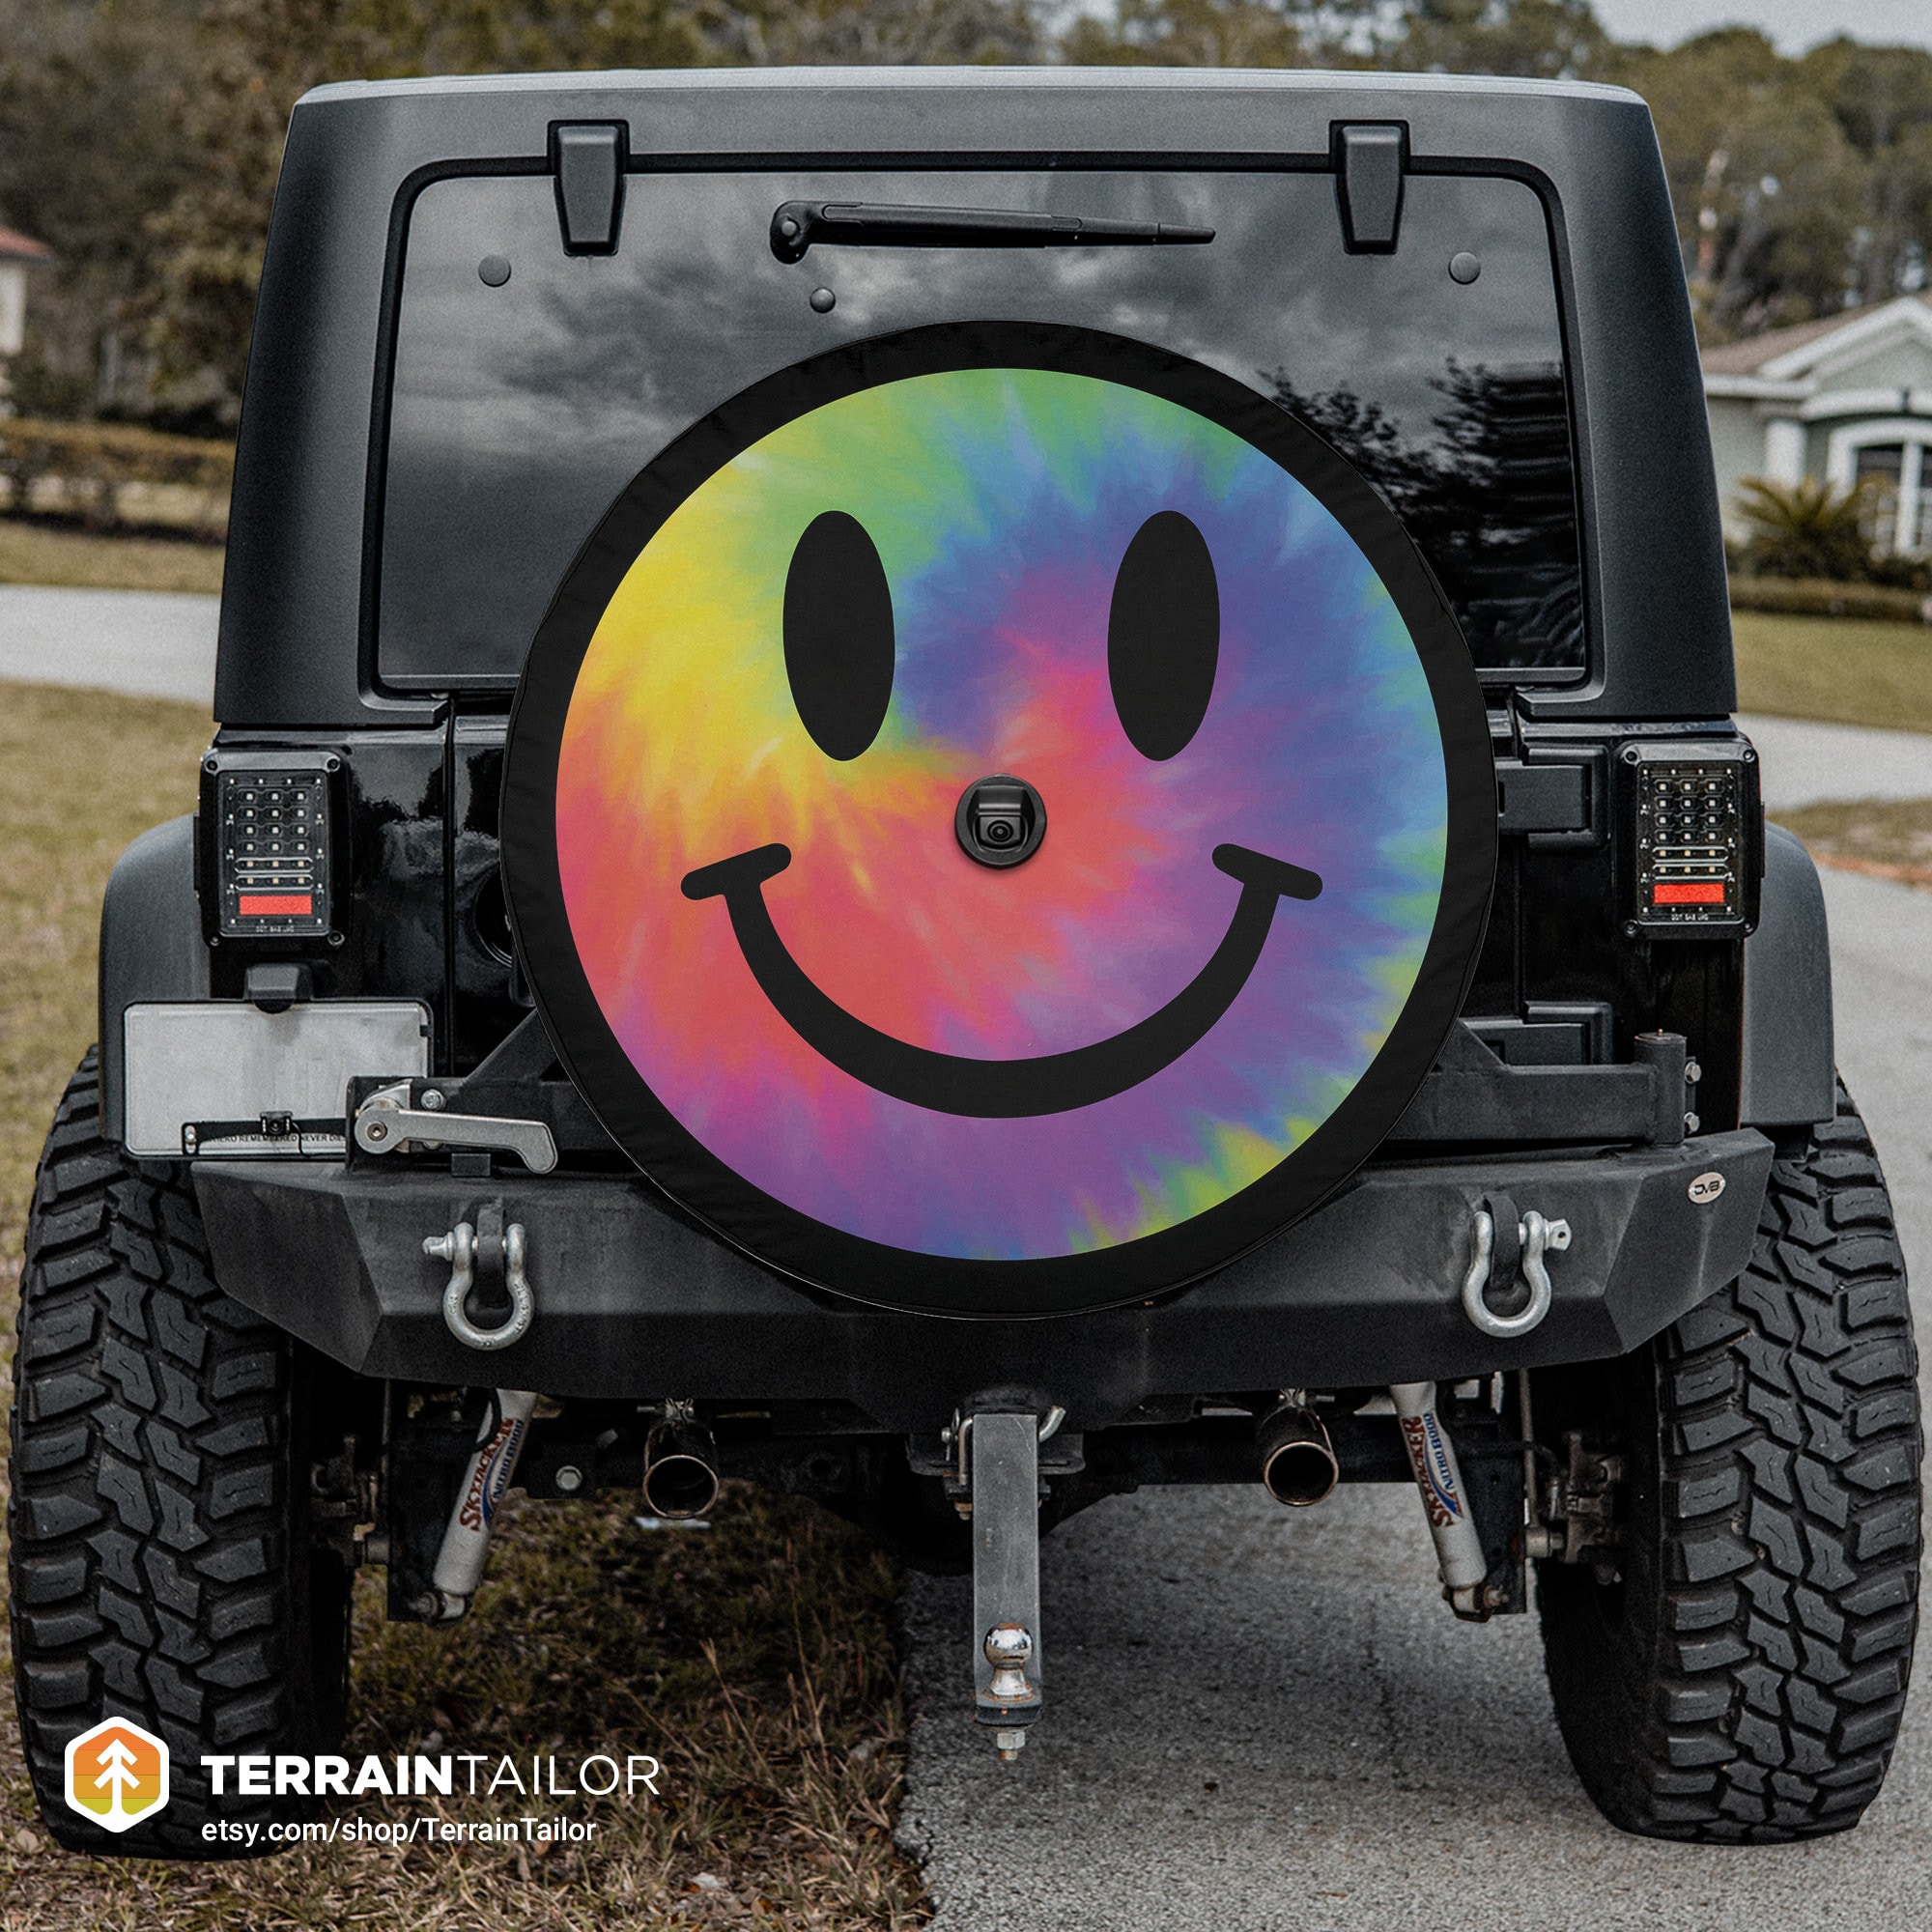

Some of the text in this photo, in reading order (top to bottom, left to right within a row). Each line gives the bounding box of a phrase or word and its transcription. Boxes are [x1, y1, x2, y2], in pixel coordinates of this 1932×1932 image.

[493, 1458, 512, 1499] NITRO
[1402, 1415, 1455, 1527] SKYJACKER
[1435, 1450, 1455, 1491] NITRO
